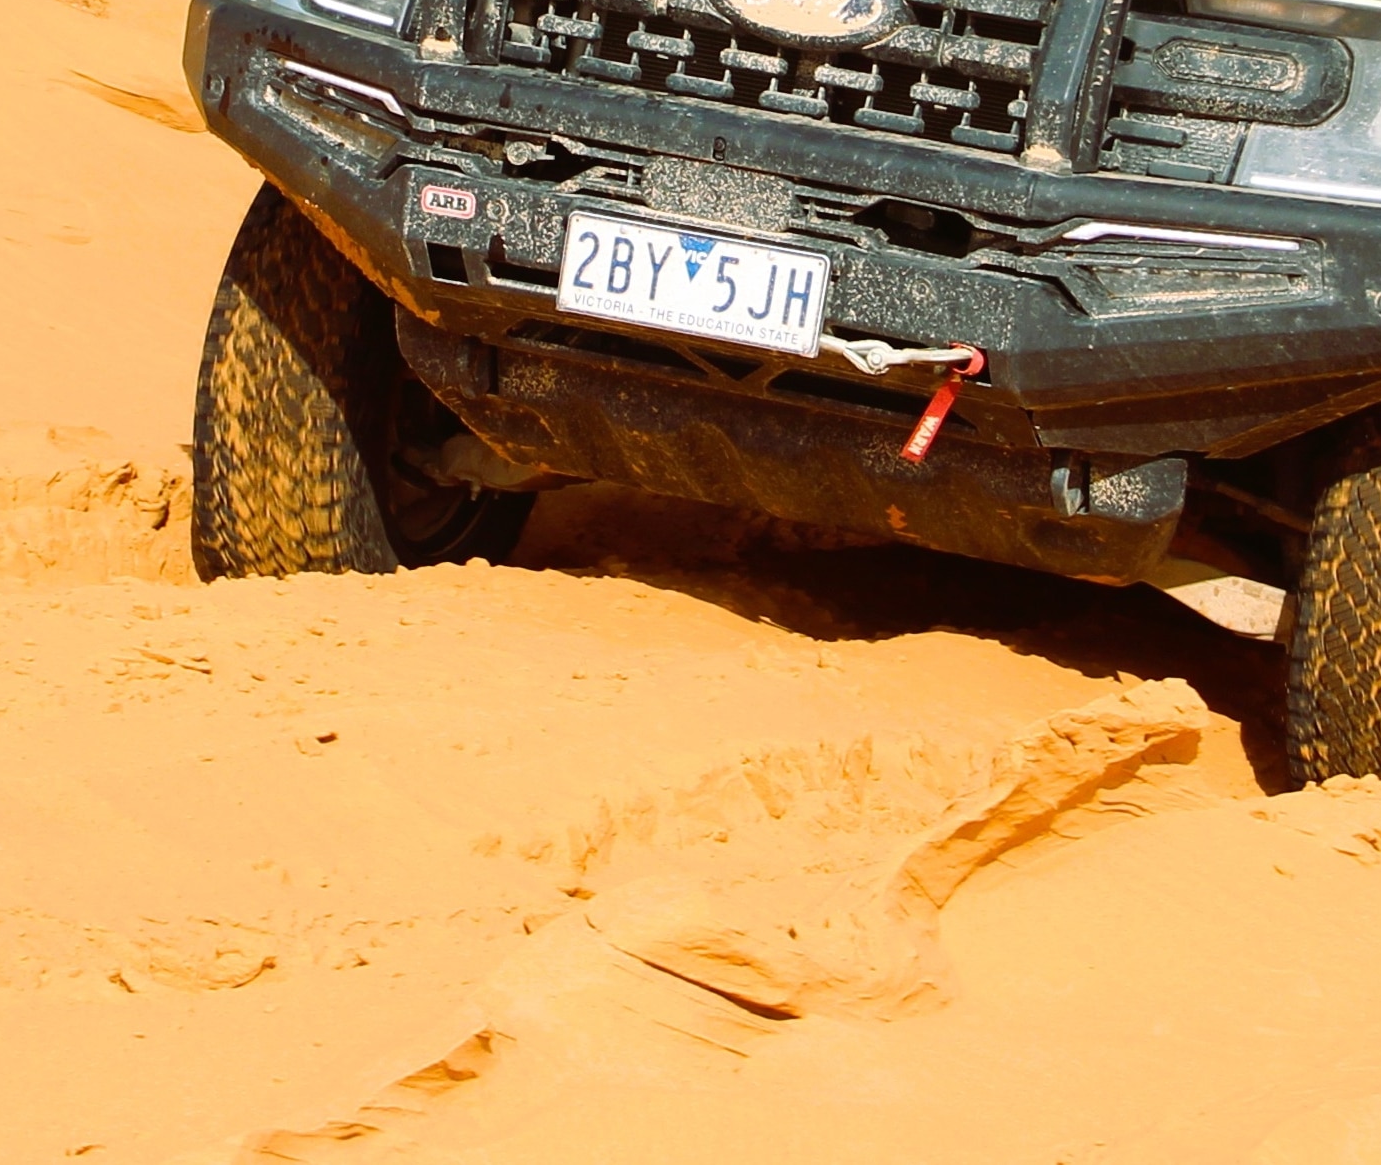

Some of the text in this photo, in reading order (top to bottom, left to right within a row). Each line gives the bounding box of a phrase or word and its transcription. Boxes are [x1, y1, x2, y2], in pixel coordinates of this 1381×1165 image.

[429, 193, 468, 211] ARB
[683, 249, 708, 264] VIC
[573, 231, 813, 328] 2BY 5JH
[574, 293, 634, 315] VICTORIA
[650, 307, 673, 321] THE
[679, 313, 754, 336] EDUCATION
[760, 328, 799, 345] STATE
[908, 416, 940, 456] WARN
